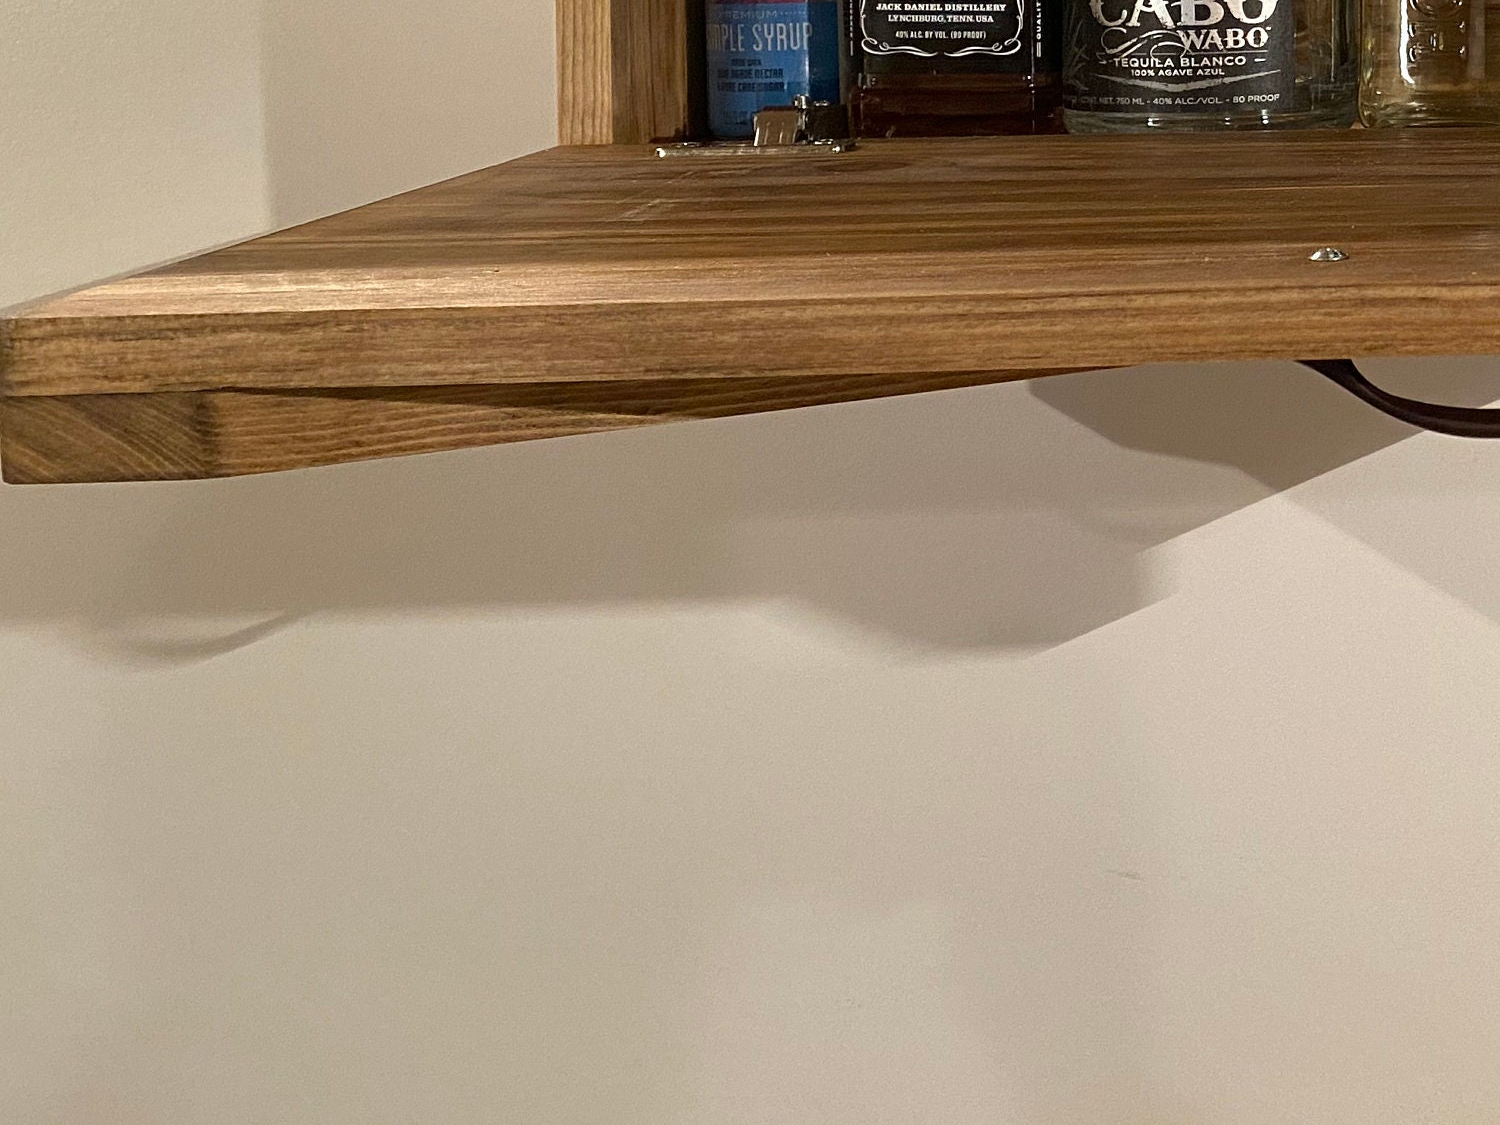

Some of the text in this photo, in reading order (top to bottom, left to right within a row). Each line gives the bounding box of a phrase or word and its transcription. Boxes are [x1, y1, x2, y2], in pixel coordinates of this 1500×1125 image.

[876, 3, 1007, 12] JACK DANIEL DISTILLERY
[976, 15, 994, 23] USA
[752, 22, 813, 52] SYRUP
[1176, 26, 1270, 51] WABO
[1113, 55, 1247, 68] TEQUILA BLANCO
[1131, 68, 1225, 77] 100% AGAVE AZUL
[1132, 97, 1145, 105] ML
[1152, 97, 1173, 105] 40%
[1232, 95, 1246, 103] 80
[1247, 93, 1280, 102] PROOF
